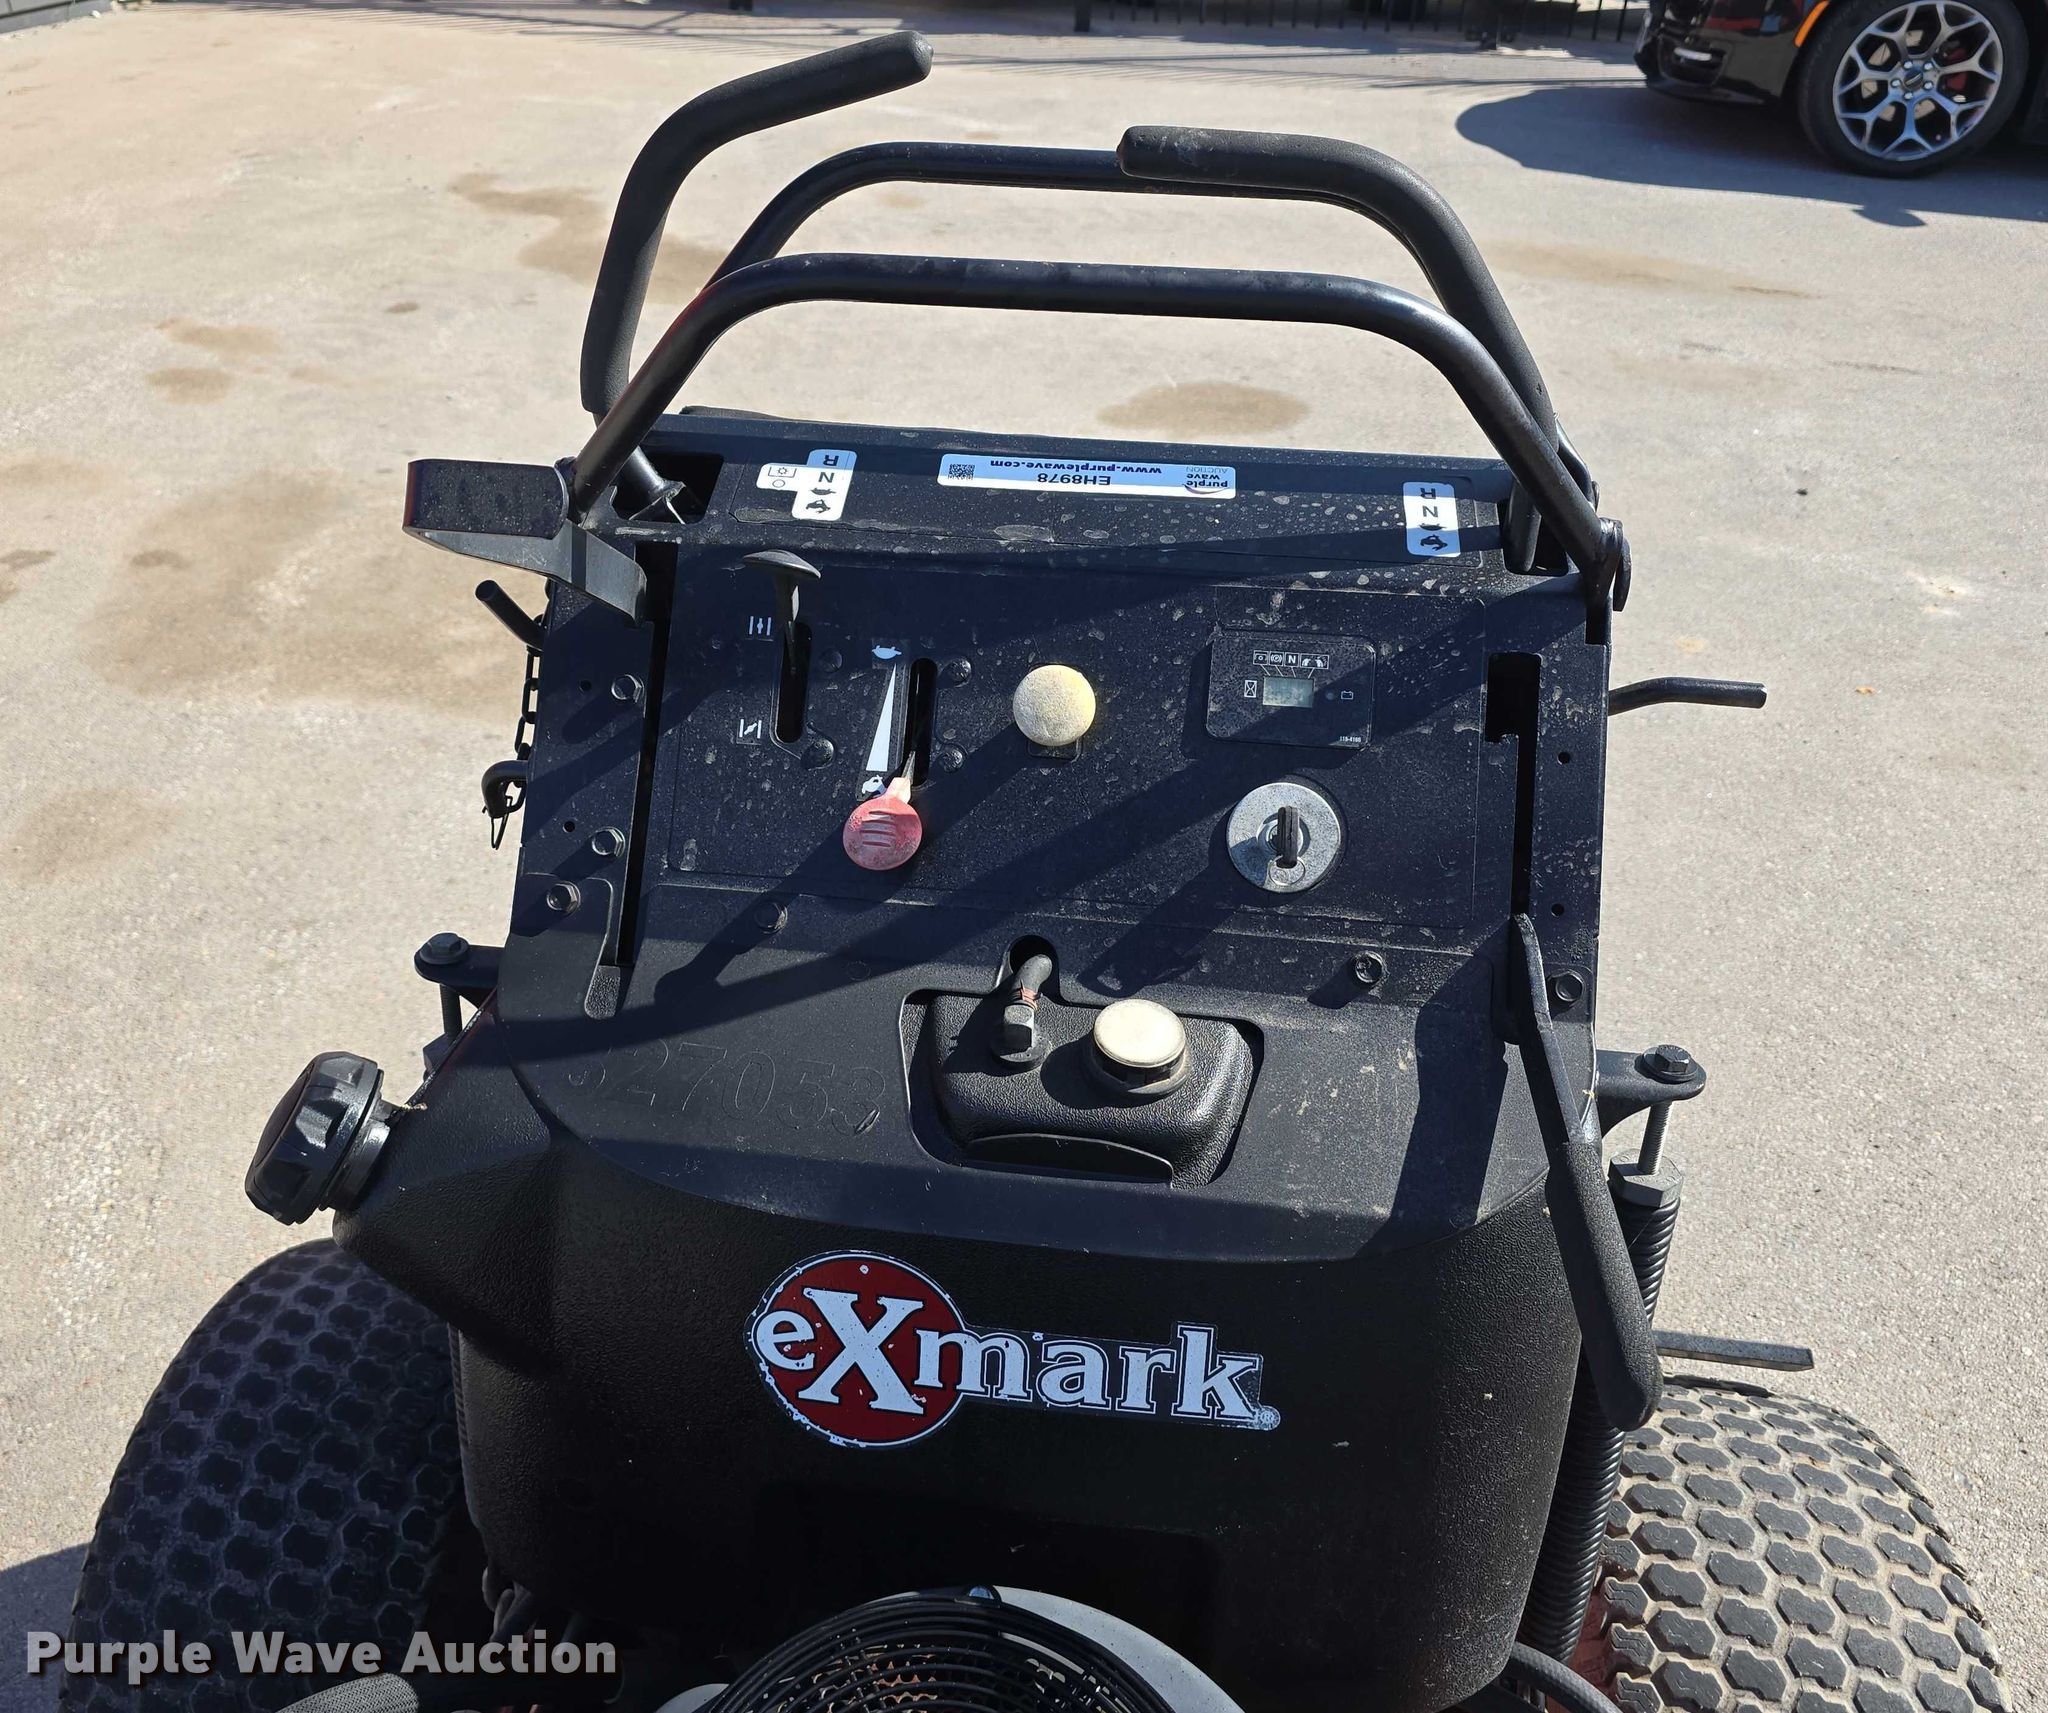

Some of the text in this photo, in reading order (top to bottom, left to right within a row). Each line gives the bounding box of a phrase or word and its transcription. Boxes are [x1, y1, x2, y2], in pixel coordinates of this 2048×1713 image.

[823, 454, 839, 466] R
[990, 460, 1161, 475] www.purplewave.com
[1186, 466, 1228, 474] AUCTION
[818, 472, 835, 483] N
[1037, 473, 1111, 486] EH8978
[1186, 480, 1228, 488] purple
[1420, 487, 1436, 500] R
[1422, 506, 1438, 518] N
[752, 1286, 1263, 1421] eXmark
